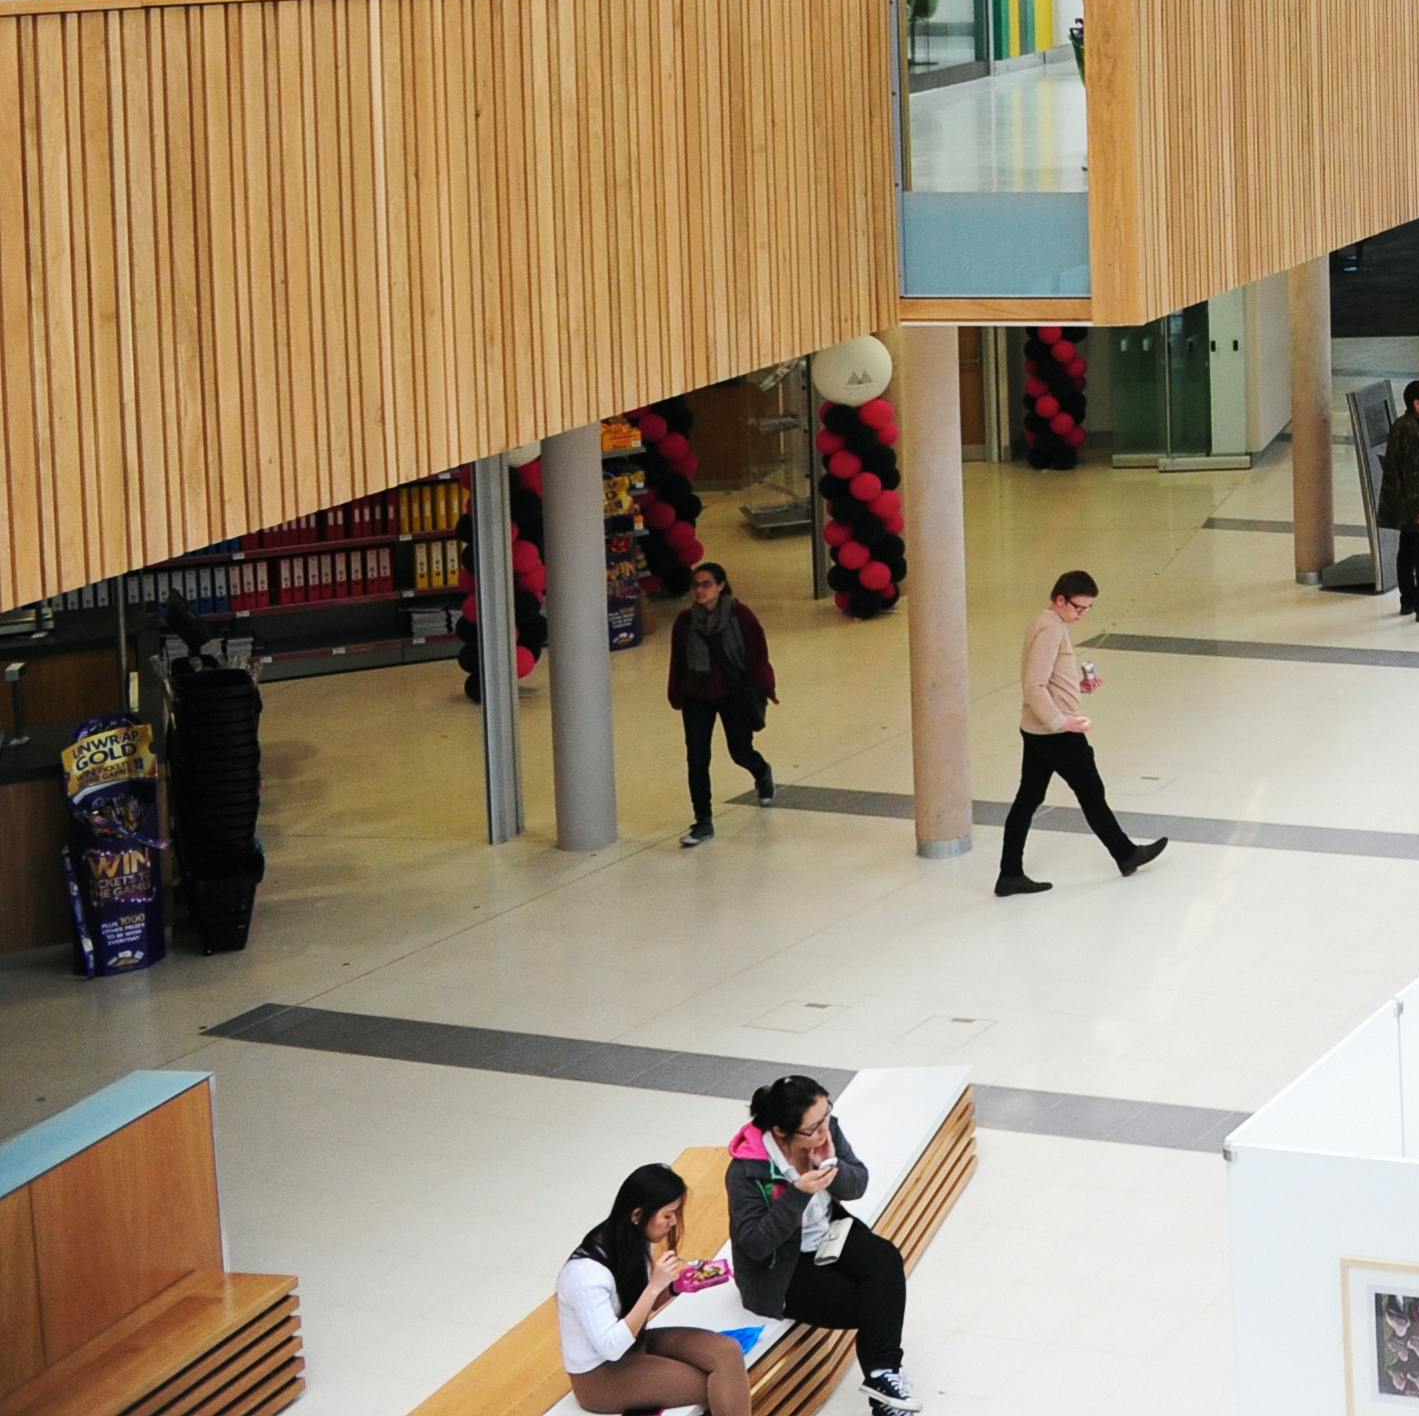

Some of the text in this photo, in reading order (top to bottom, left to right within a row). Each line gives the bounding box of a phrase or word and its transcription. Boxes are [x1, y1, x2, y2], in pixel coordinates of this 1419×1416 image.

[72, 730, 139, 759] UNWRAP
[76, 743, 137, 772] GOLD
[88, 849, 150, 878] WIN
